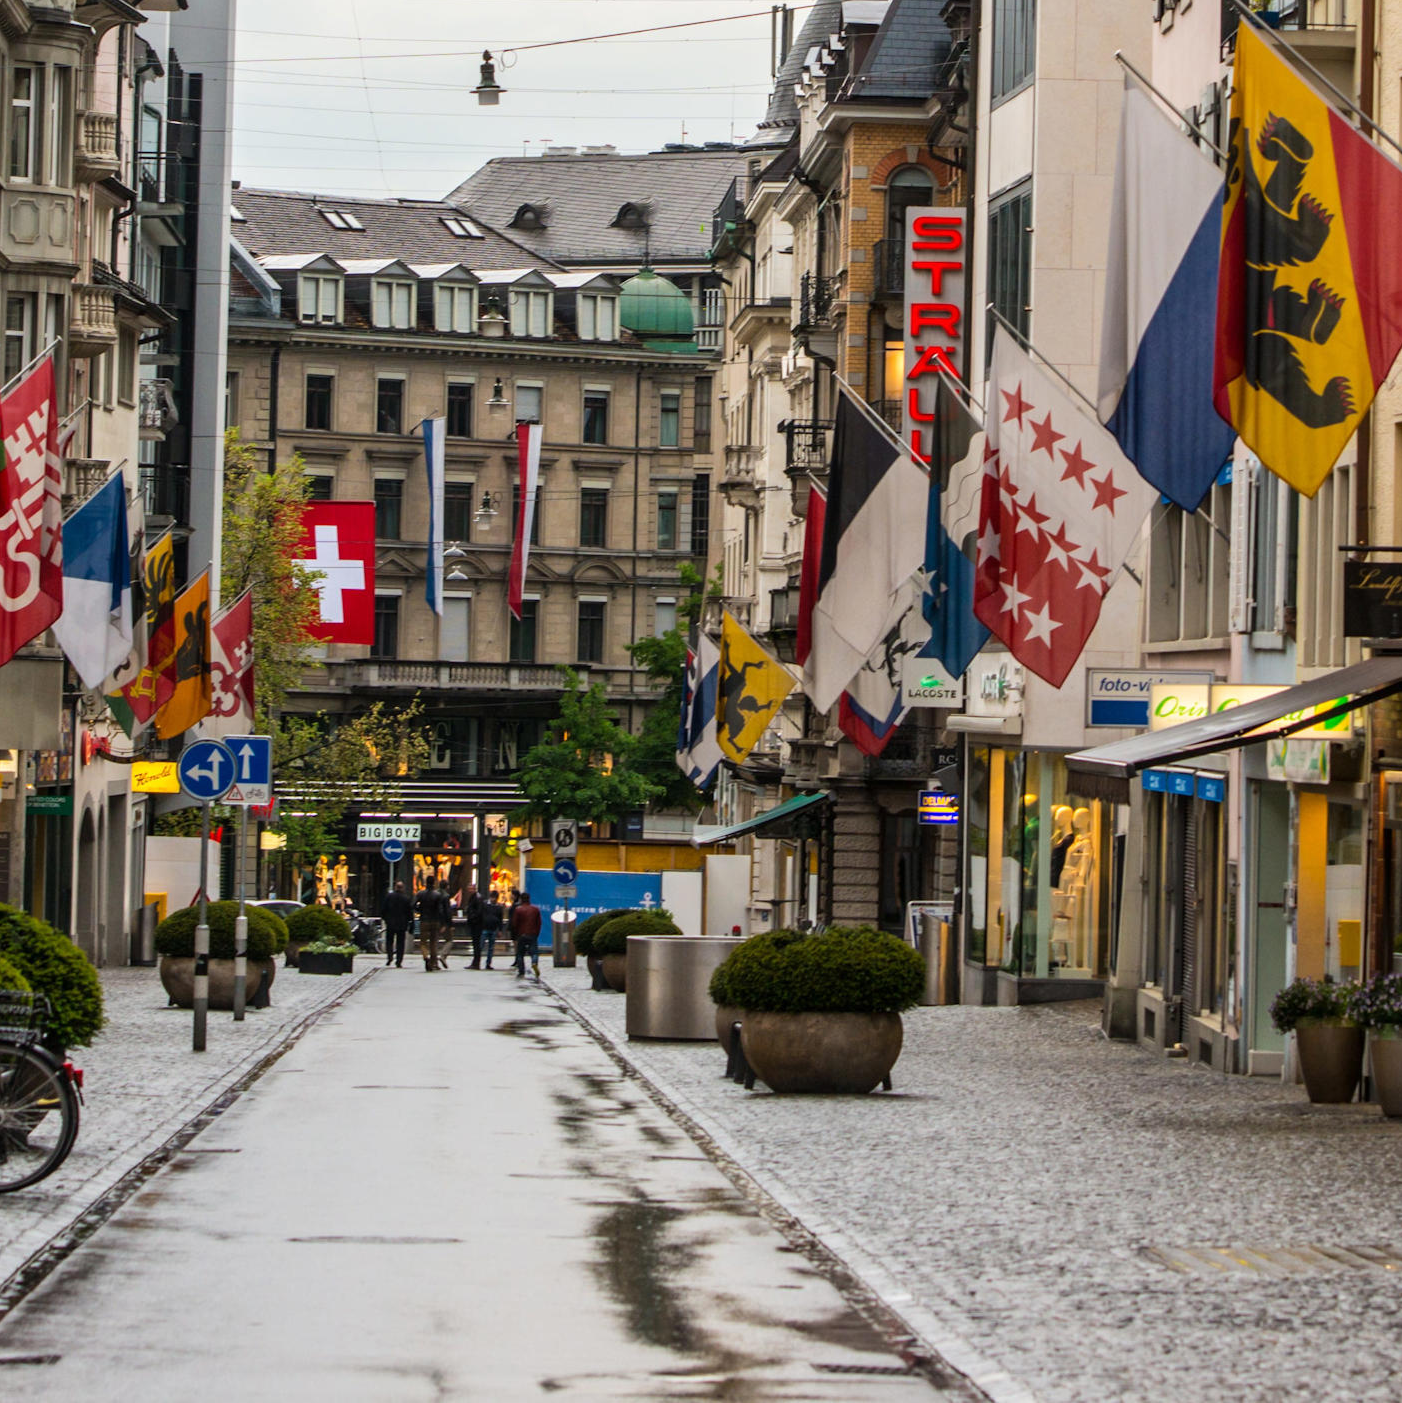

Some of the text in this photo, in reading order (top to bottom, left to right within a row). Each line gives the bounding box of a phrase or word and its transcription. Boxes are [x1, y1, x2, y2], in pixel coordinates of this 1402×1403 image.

[1099, 677, 1164, 692] foto-vi
[908, 689, 957, 698] LACOSTE
[360, 827, 419, 838] BIG BOYZ
